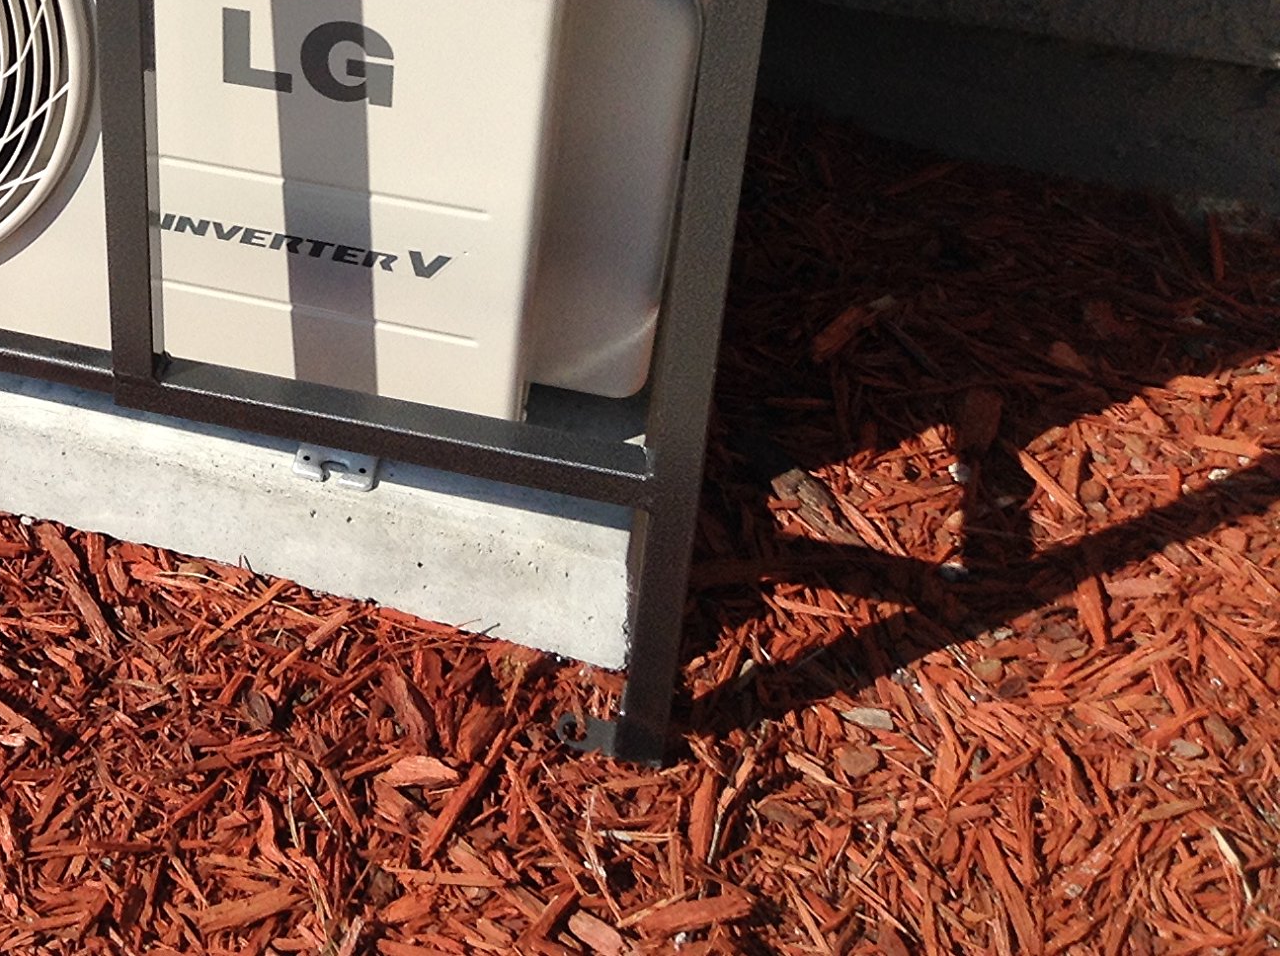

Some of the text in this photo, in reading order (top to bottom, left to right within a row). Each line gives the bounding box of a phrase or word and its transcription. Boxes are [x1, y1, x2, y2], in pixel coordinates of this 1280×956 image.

[222, 8, 395, 108] LG
[160, 213, 451, 279] INVERTER V
